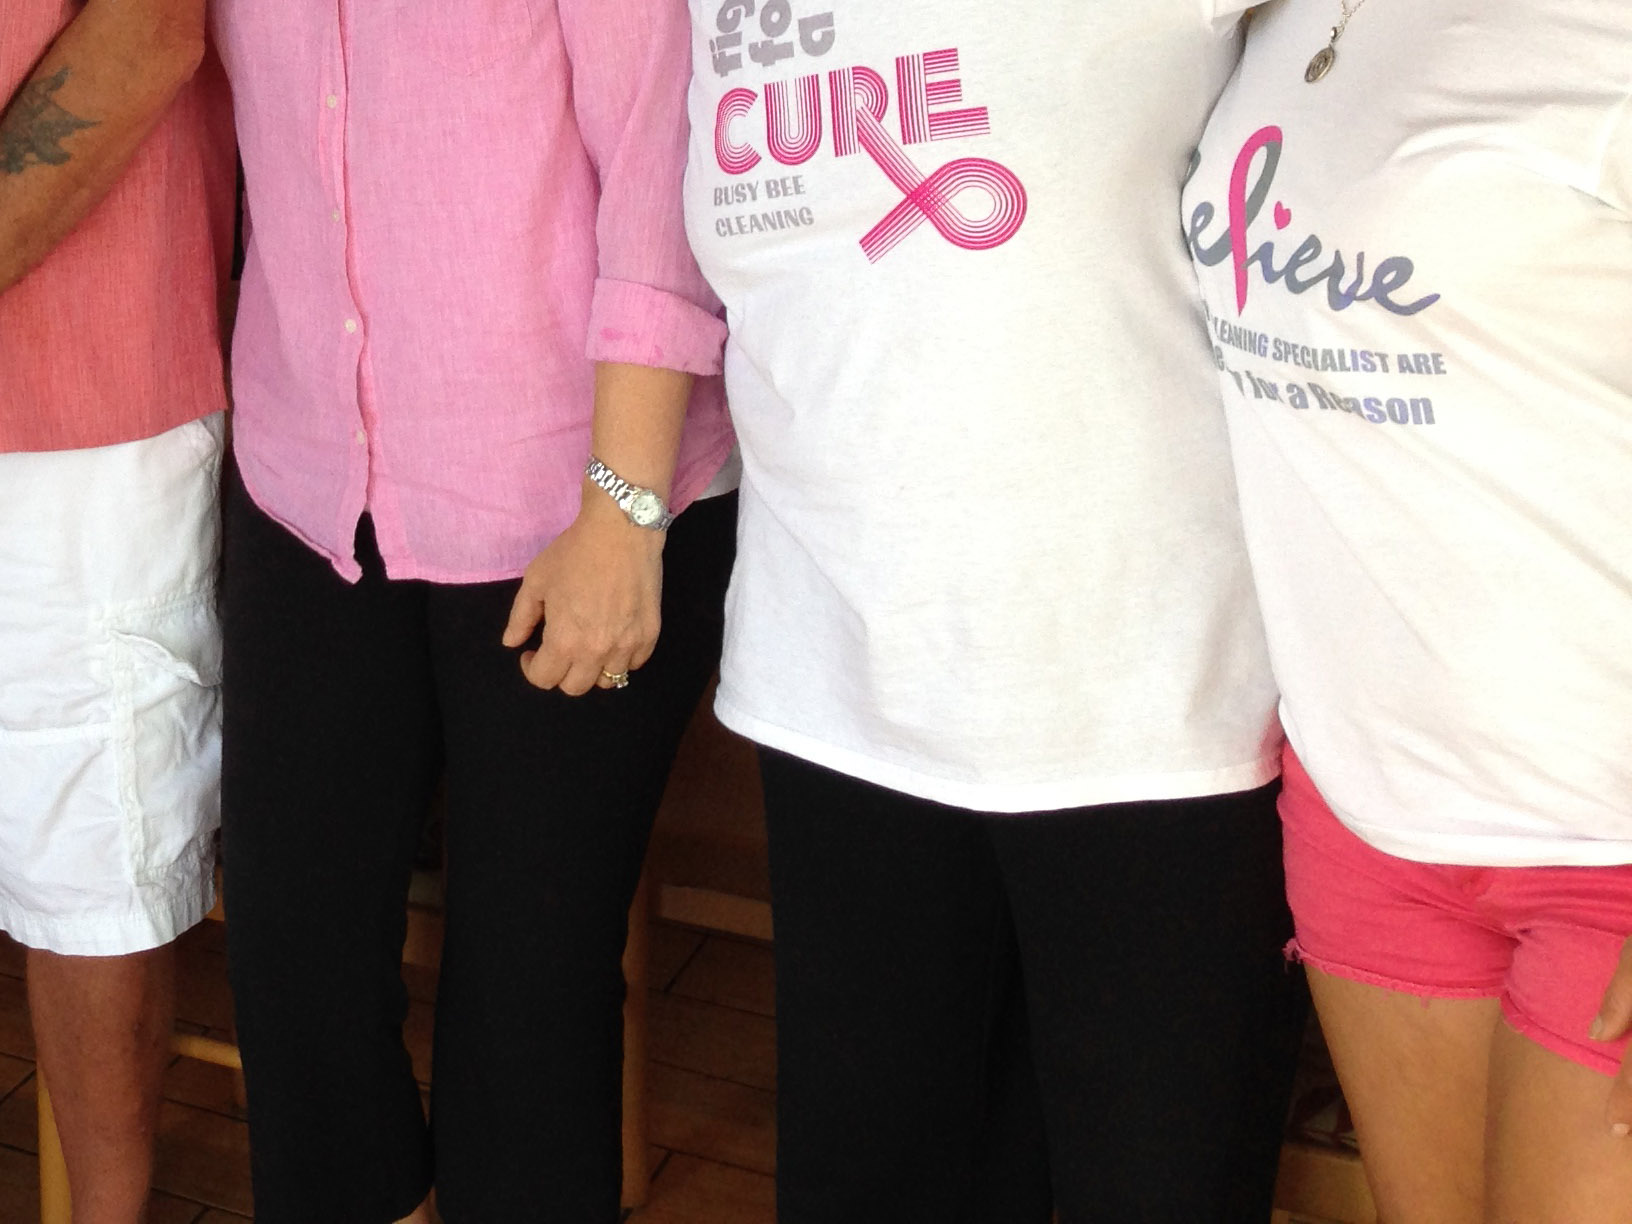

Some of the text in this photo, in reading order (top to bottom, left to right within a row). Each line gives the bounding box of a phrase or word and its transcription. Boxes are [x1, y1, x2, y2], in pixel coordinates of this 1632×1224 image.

[798, 11, 836, 57] a
[714, 47, 991, 175] CURE
[713, 175, 806, 207] BUSY BEE
[715, 206, 815, 238] CLEANING
[1186, 125, 1441, 316] elieve
[1210, 316, 1269, 358] LEANING
[1272, 337, 1390, 374] SPECIALIST
[1396, 352, 1447, 375] ARE
[1286, 382, 1309, 410] a
